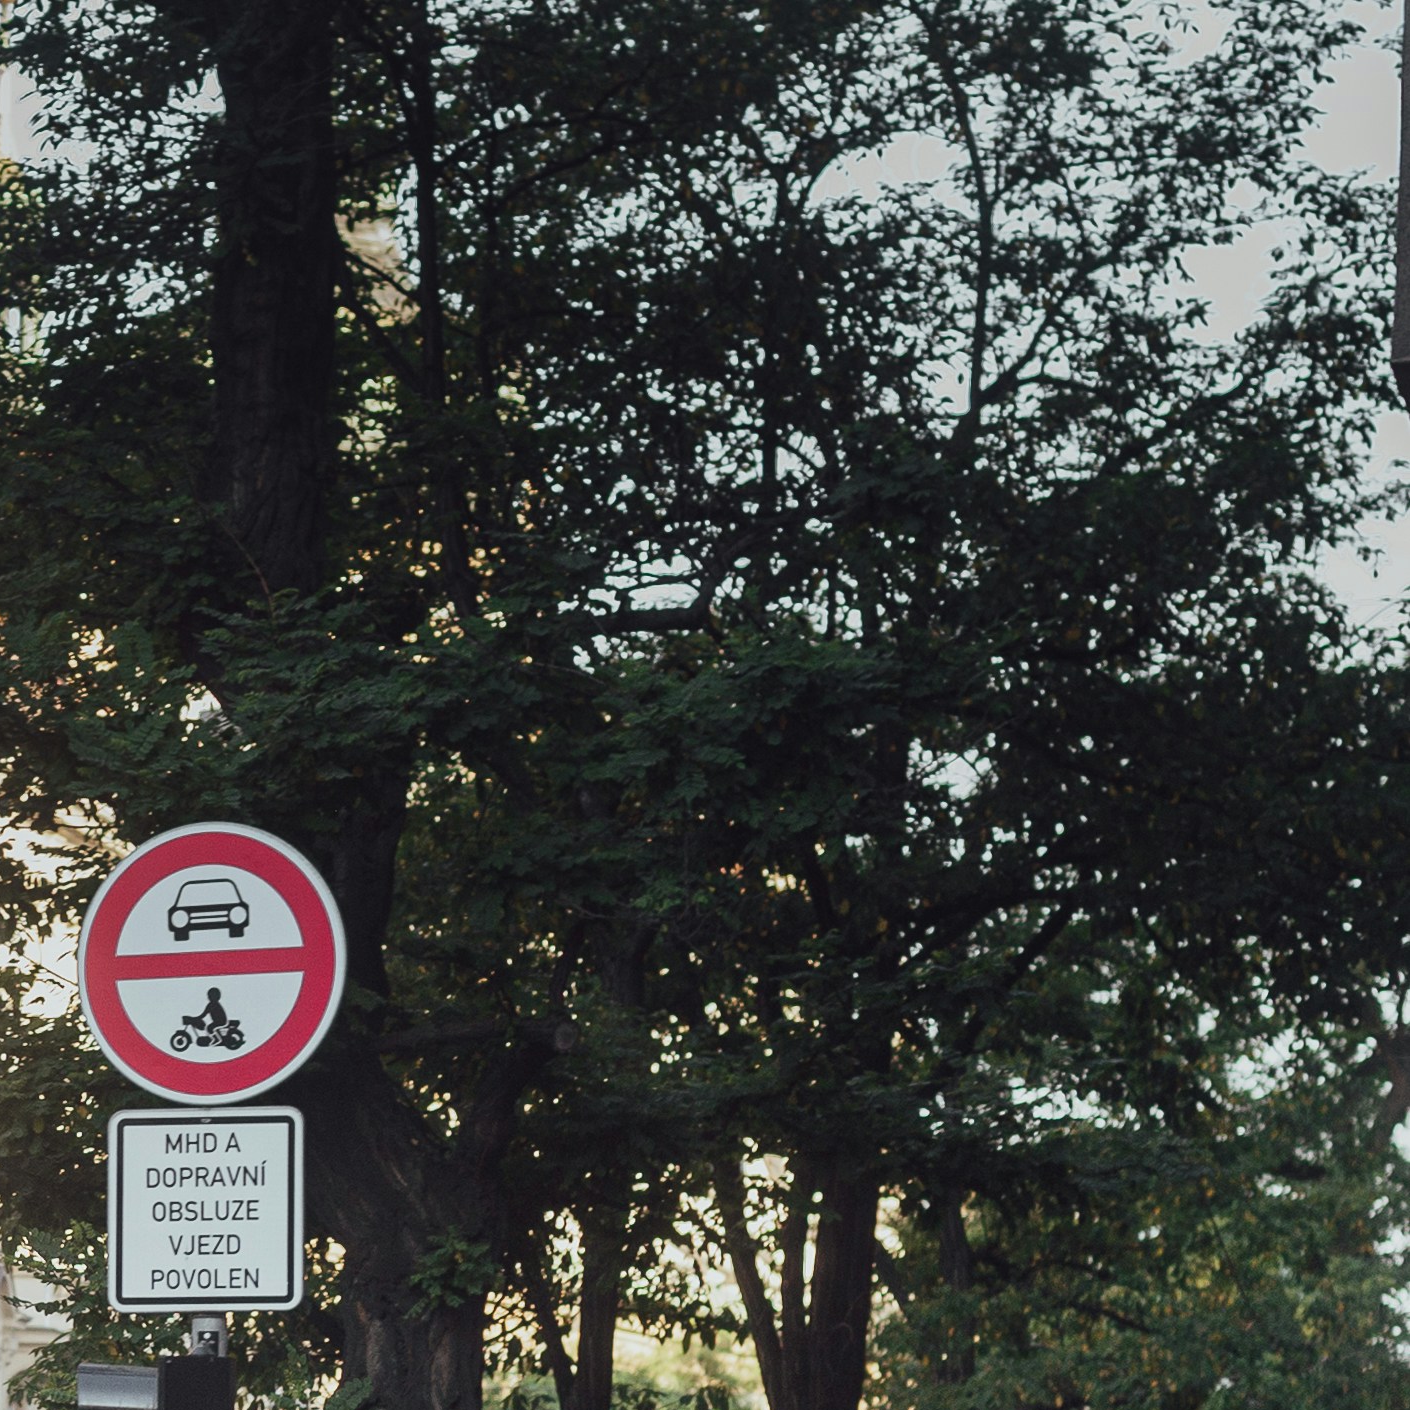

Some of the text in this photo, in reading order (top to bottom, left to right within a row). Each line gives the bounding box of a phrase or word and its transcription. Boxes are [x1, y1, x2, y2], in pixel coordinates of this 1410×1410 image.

[165, 1132, 241, 1154] MHD A
[146, 1160, 267, 1188] DOPRAVNÍ
[152, 1200, 260, 1222] OBSLUZE
[169, 1234, 241, 1255] VJEZD
[151, 1268, 260, 1290] POVOLEN
